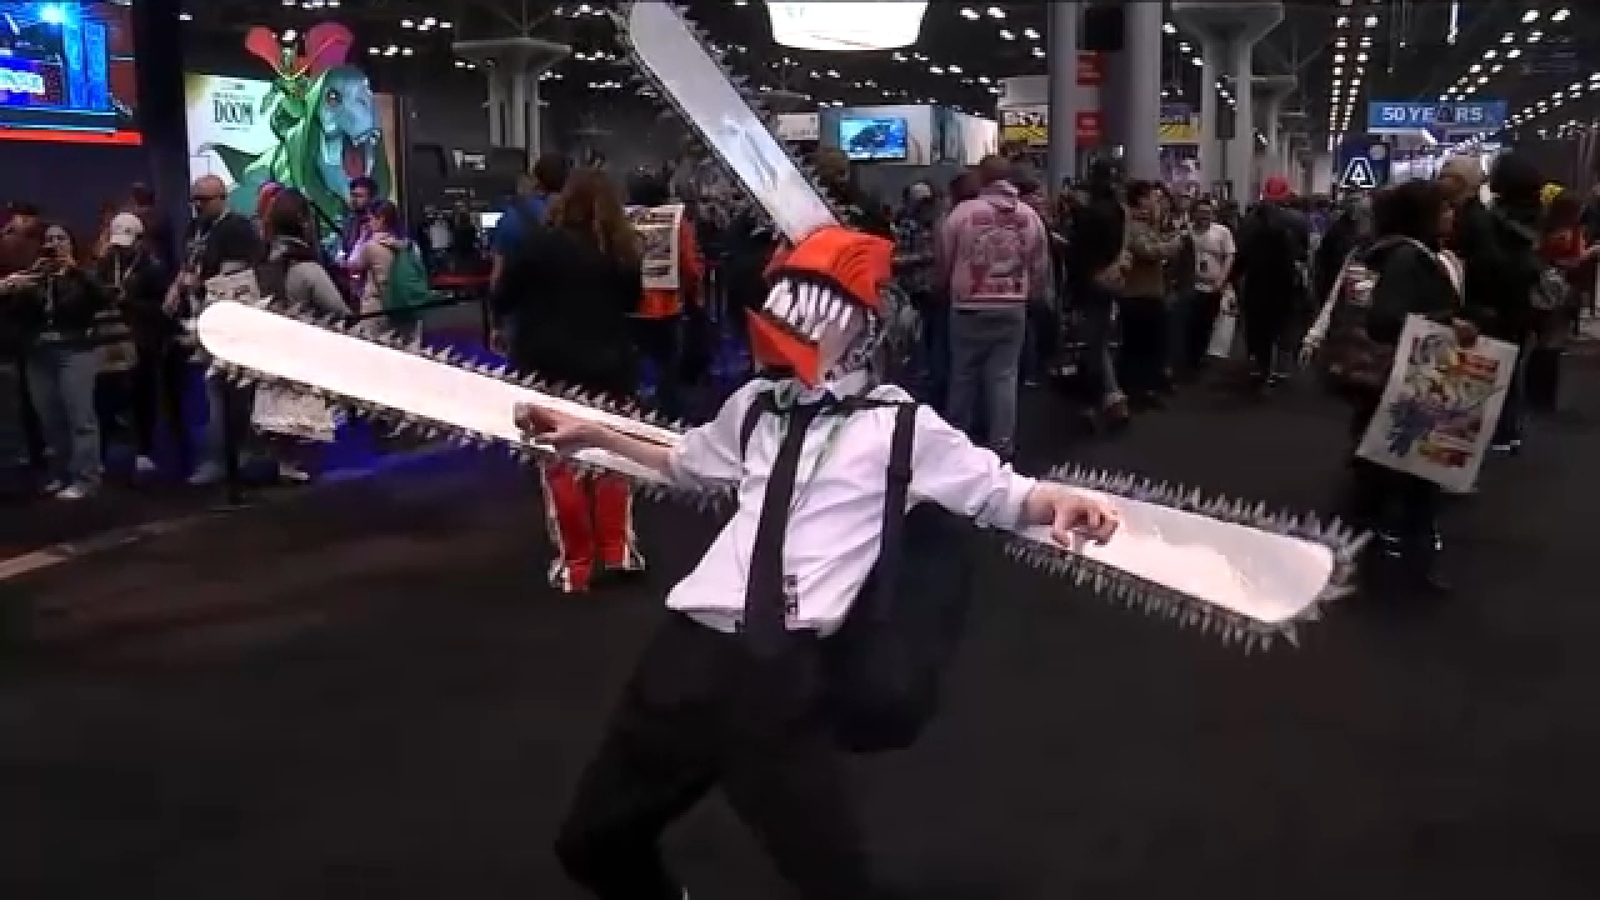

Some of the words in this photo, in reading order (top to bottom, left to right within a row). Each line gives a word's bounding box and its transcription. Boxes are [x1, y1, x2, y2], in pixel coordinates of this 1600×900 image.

[214, 100, 253, 125] DOOM
[1382, 107, 1405, 121] 50
[1408, 107, 1483, 121] YERS
